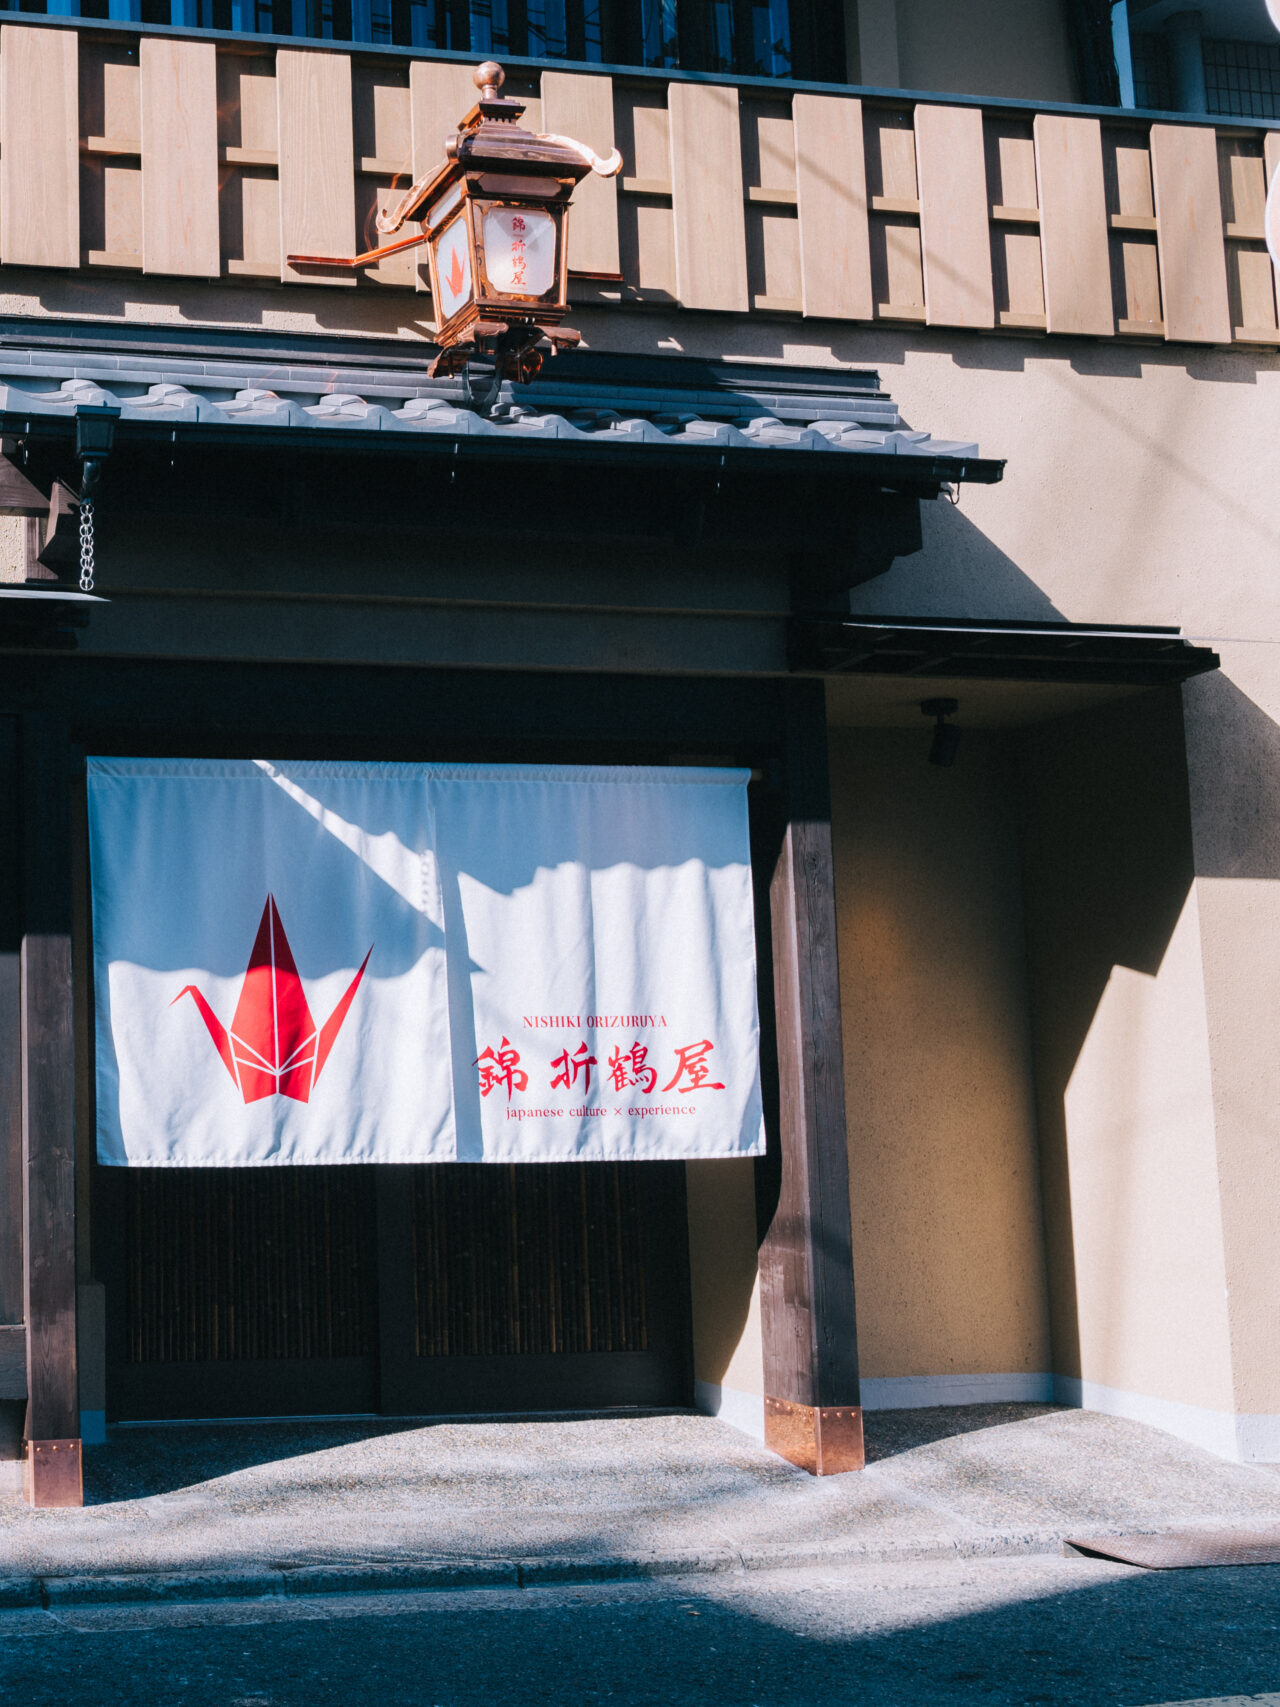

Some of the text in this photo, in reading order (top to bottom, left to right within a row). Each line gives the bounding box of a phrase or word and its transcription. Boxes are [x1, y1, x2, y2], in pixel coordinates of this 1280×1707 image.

[523, 1014, 668, 1029] NISHIKI ORIZURUYA
[472, 1036, 726, 1102] 錦折鶴屋
[506, 1106, 564, 1121] japanese
[569, 1105, 607, 1117] culture
[628, 1104, 696, 1120] experience
